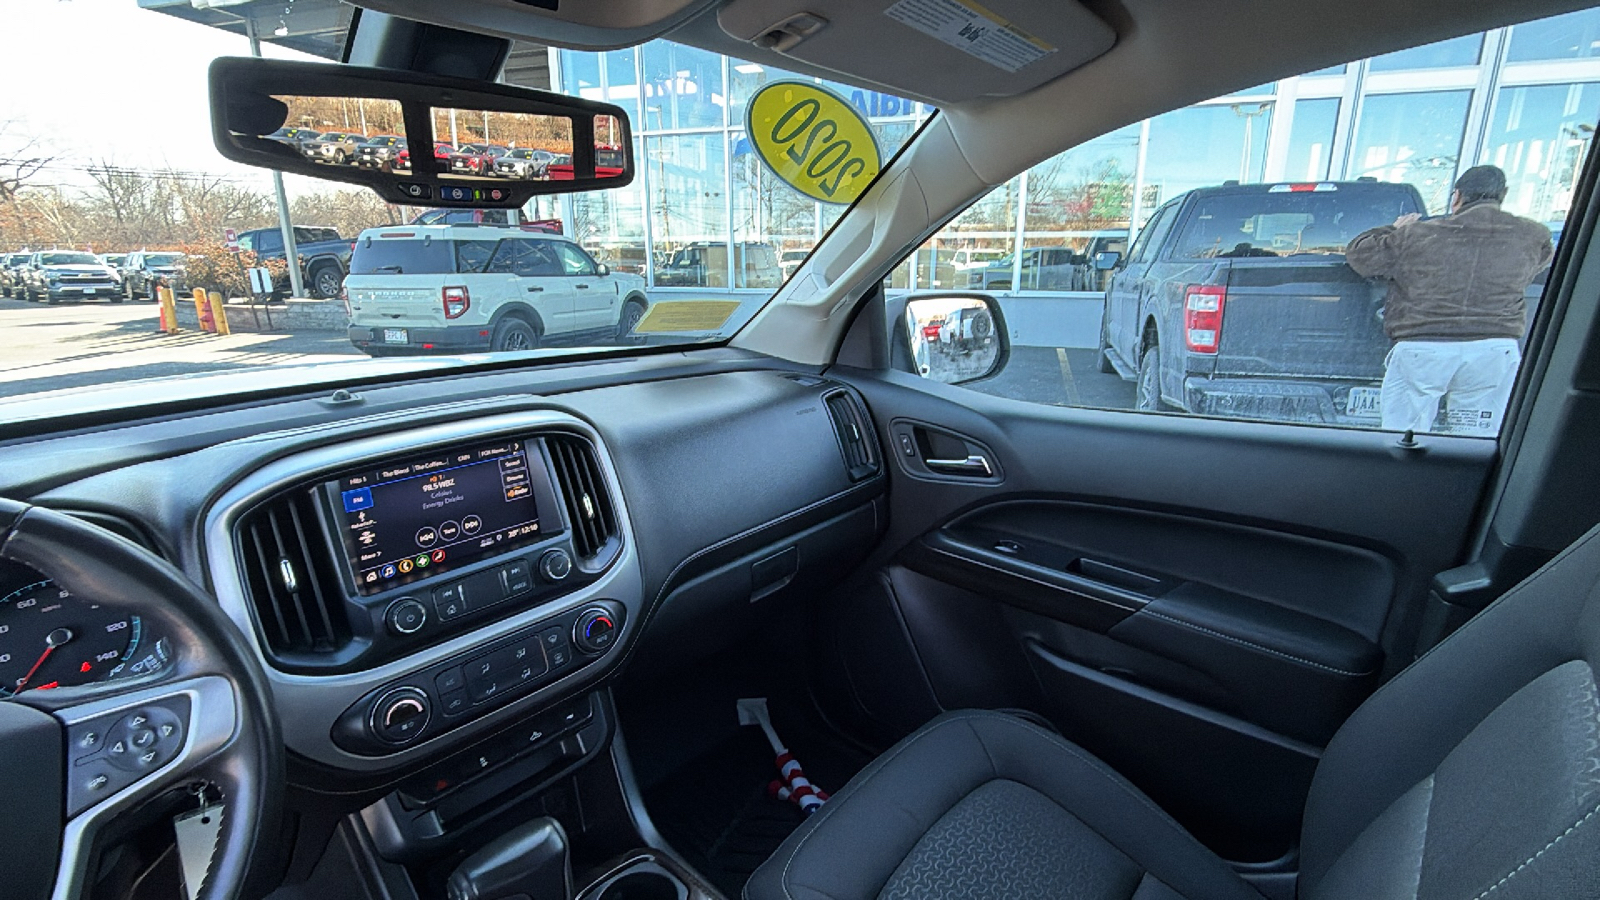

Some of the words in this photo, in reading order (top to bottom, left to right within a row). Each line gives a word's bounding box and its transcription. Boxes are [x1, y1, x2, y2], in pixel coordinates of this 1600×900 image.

[1352, 395, 1380, 409] UAA-
[16, 598, 36, 609] 60
[105, 621, 127, 632] 120
[96, 650, 118, 662] 140
